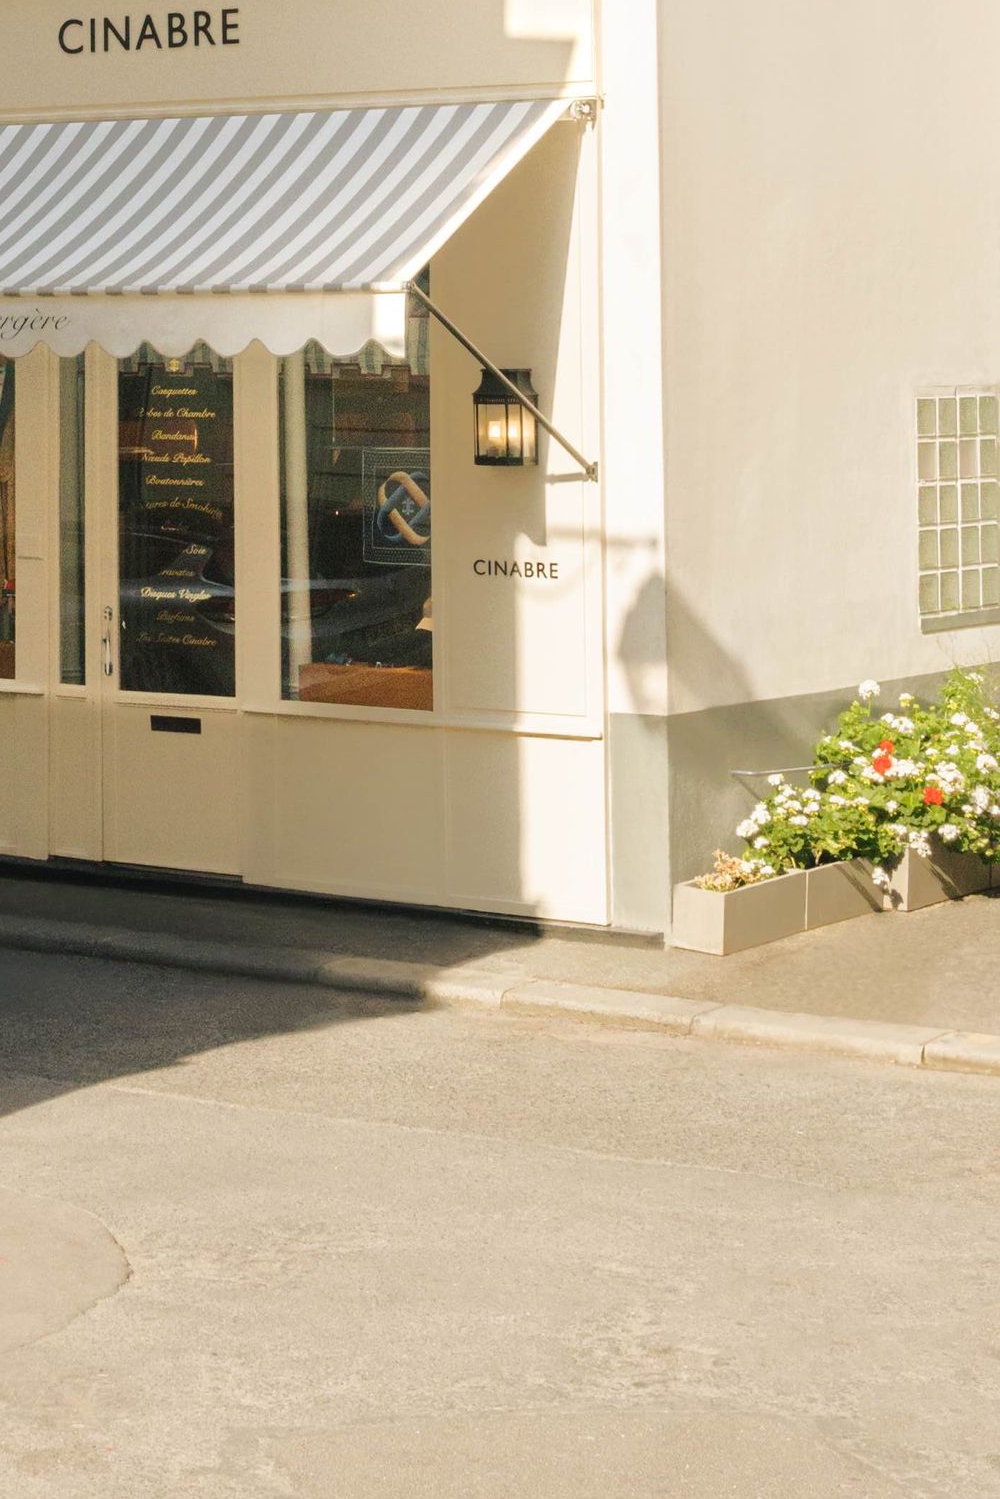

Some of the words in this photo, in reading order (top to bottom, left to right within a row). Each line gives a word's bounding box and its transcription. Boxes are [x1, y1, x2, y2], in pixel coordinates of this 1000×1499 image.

[58, 8, 240, 54] CINABRE
[163, 407, 174, 418] de
[177, 407, 216, 418] Chambre
[473, 559, 558, 579] CINABRE
